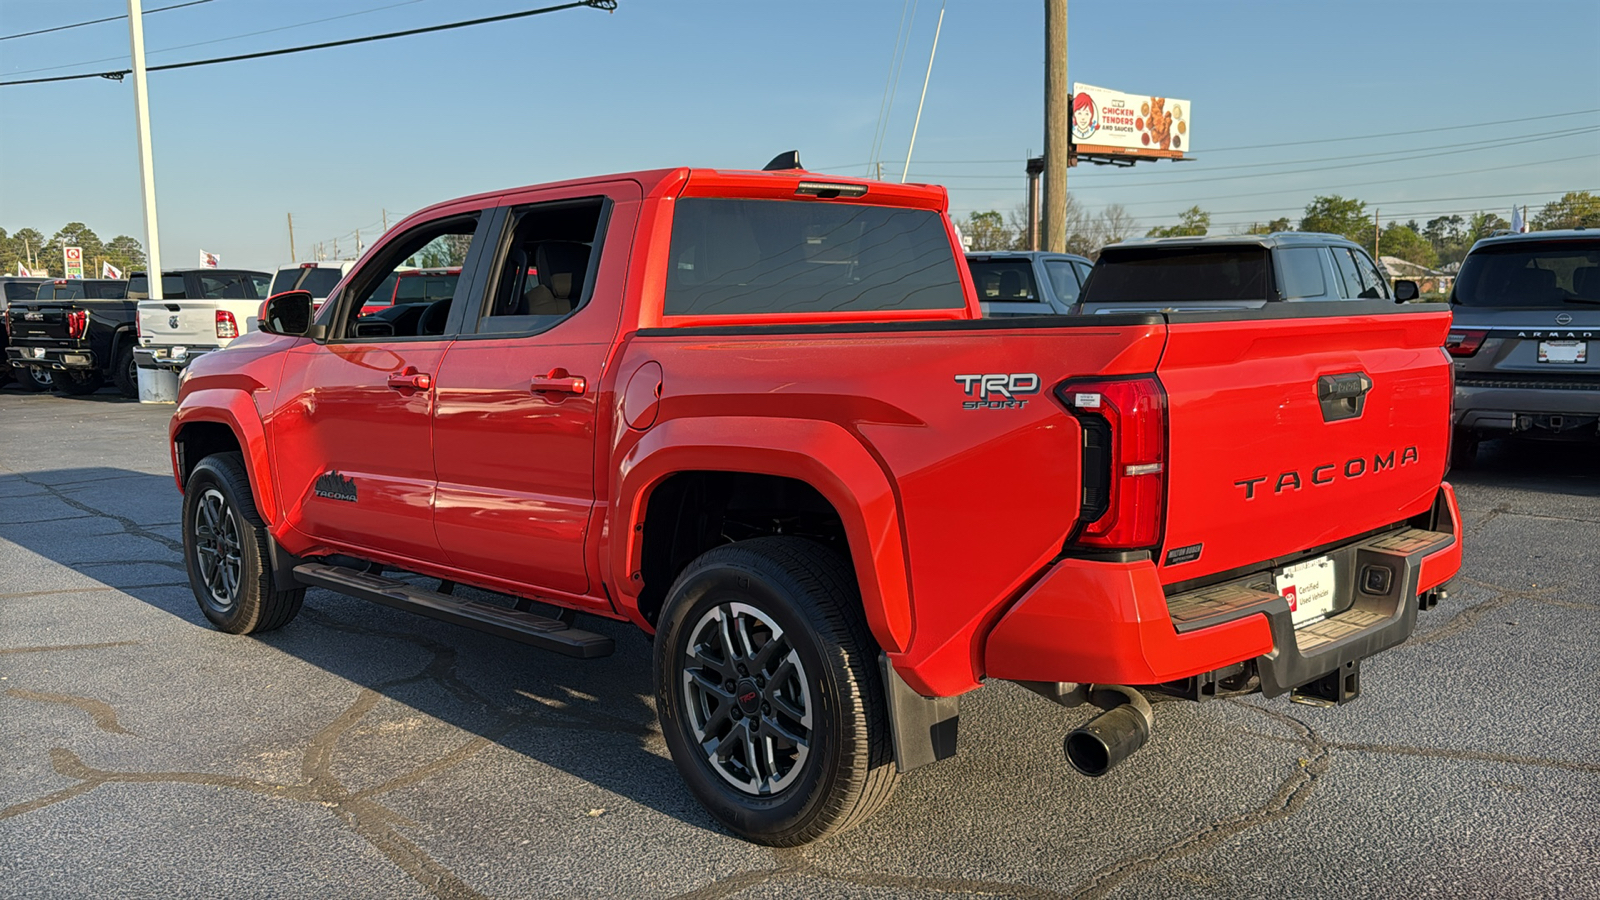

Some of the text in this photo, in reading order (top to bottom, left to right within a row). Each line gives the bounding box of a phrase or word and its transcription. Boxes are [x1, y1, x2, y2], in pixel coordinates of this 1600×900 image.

[1102, 107, 1134, 116] CHICKEN
[1102, 116, 1134, 125] TENDERS
[954, 373, 1041, 399] TRD
[962, 400, 1028, 410] SPORT
[1234, 446, 1418, 500] TACOMA
[315, 490, 358, 502] TACOMA
[1299, 581, 1319, 595] Certified
[1299, 590, 1329, 605] Used Vehicles
[739, 692, 756, 703] TRD
